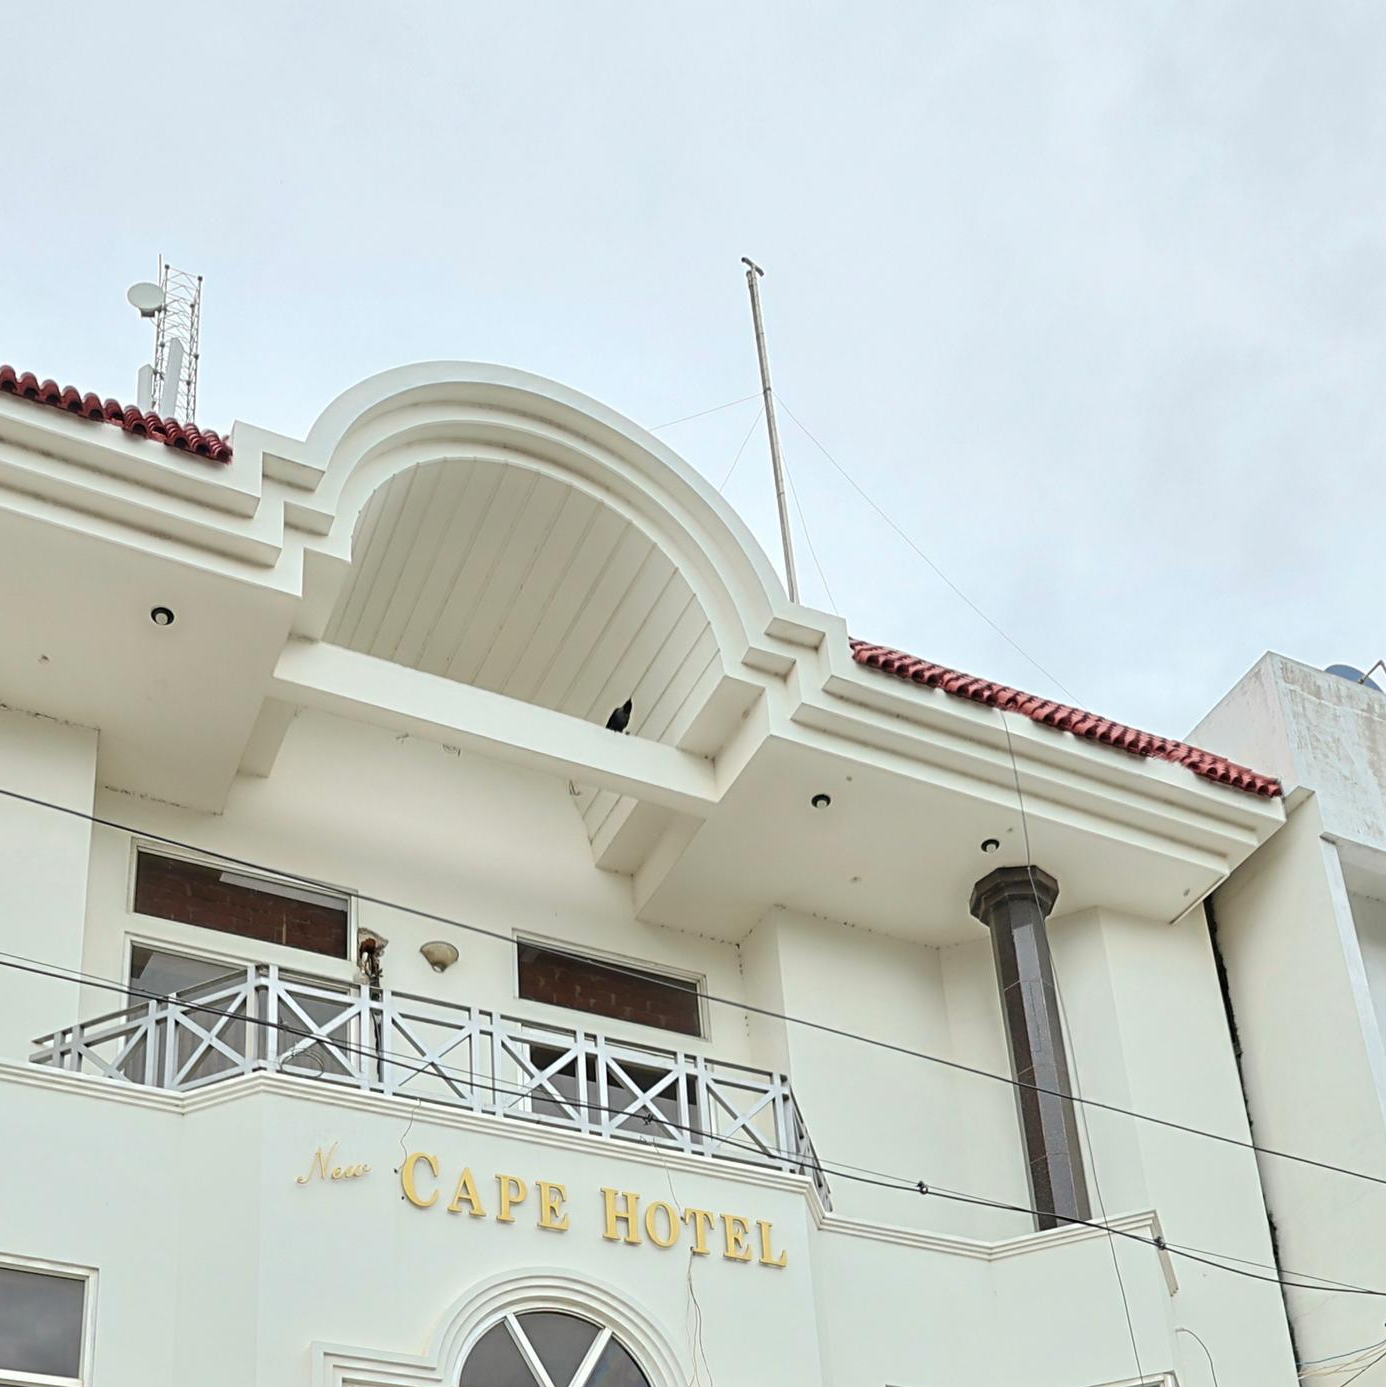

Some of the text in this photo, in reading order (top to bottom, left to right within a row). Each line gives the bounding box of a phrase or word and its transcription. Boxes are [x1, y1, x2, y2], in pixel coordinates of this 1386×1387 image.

[295, 1142, 787, 1268] New CAPE HOTEL
